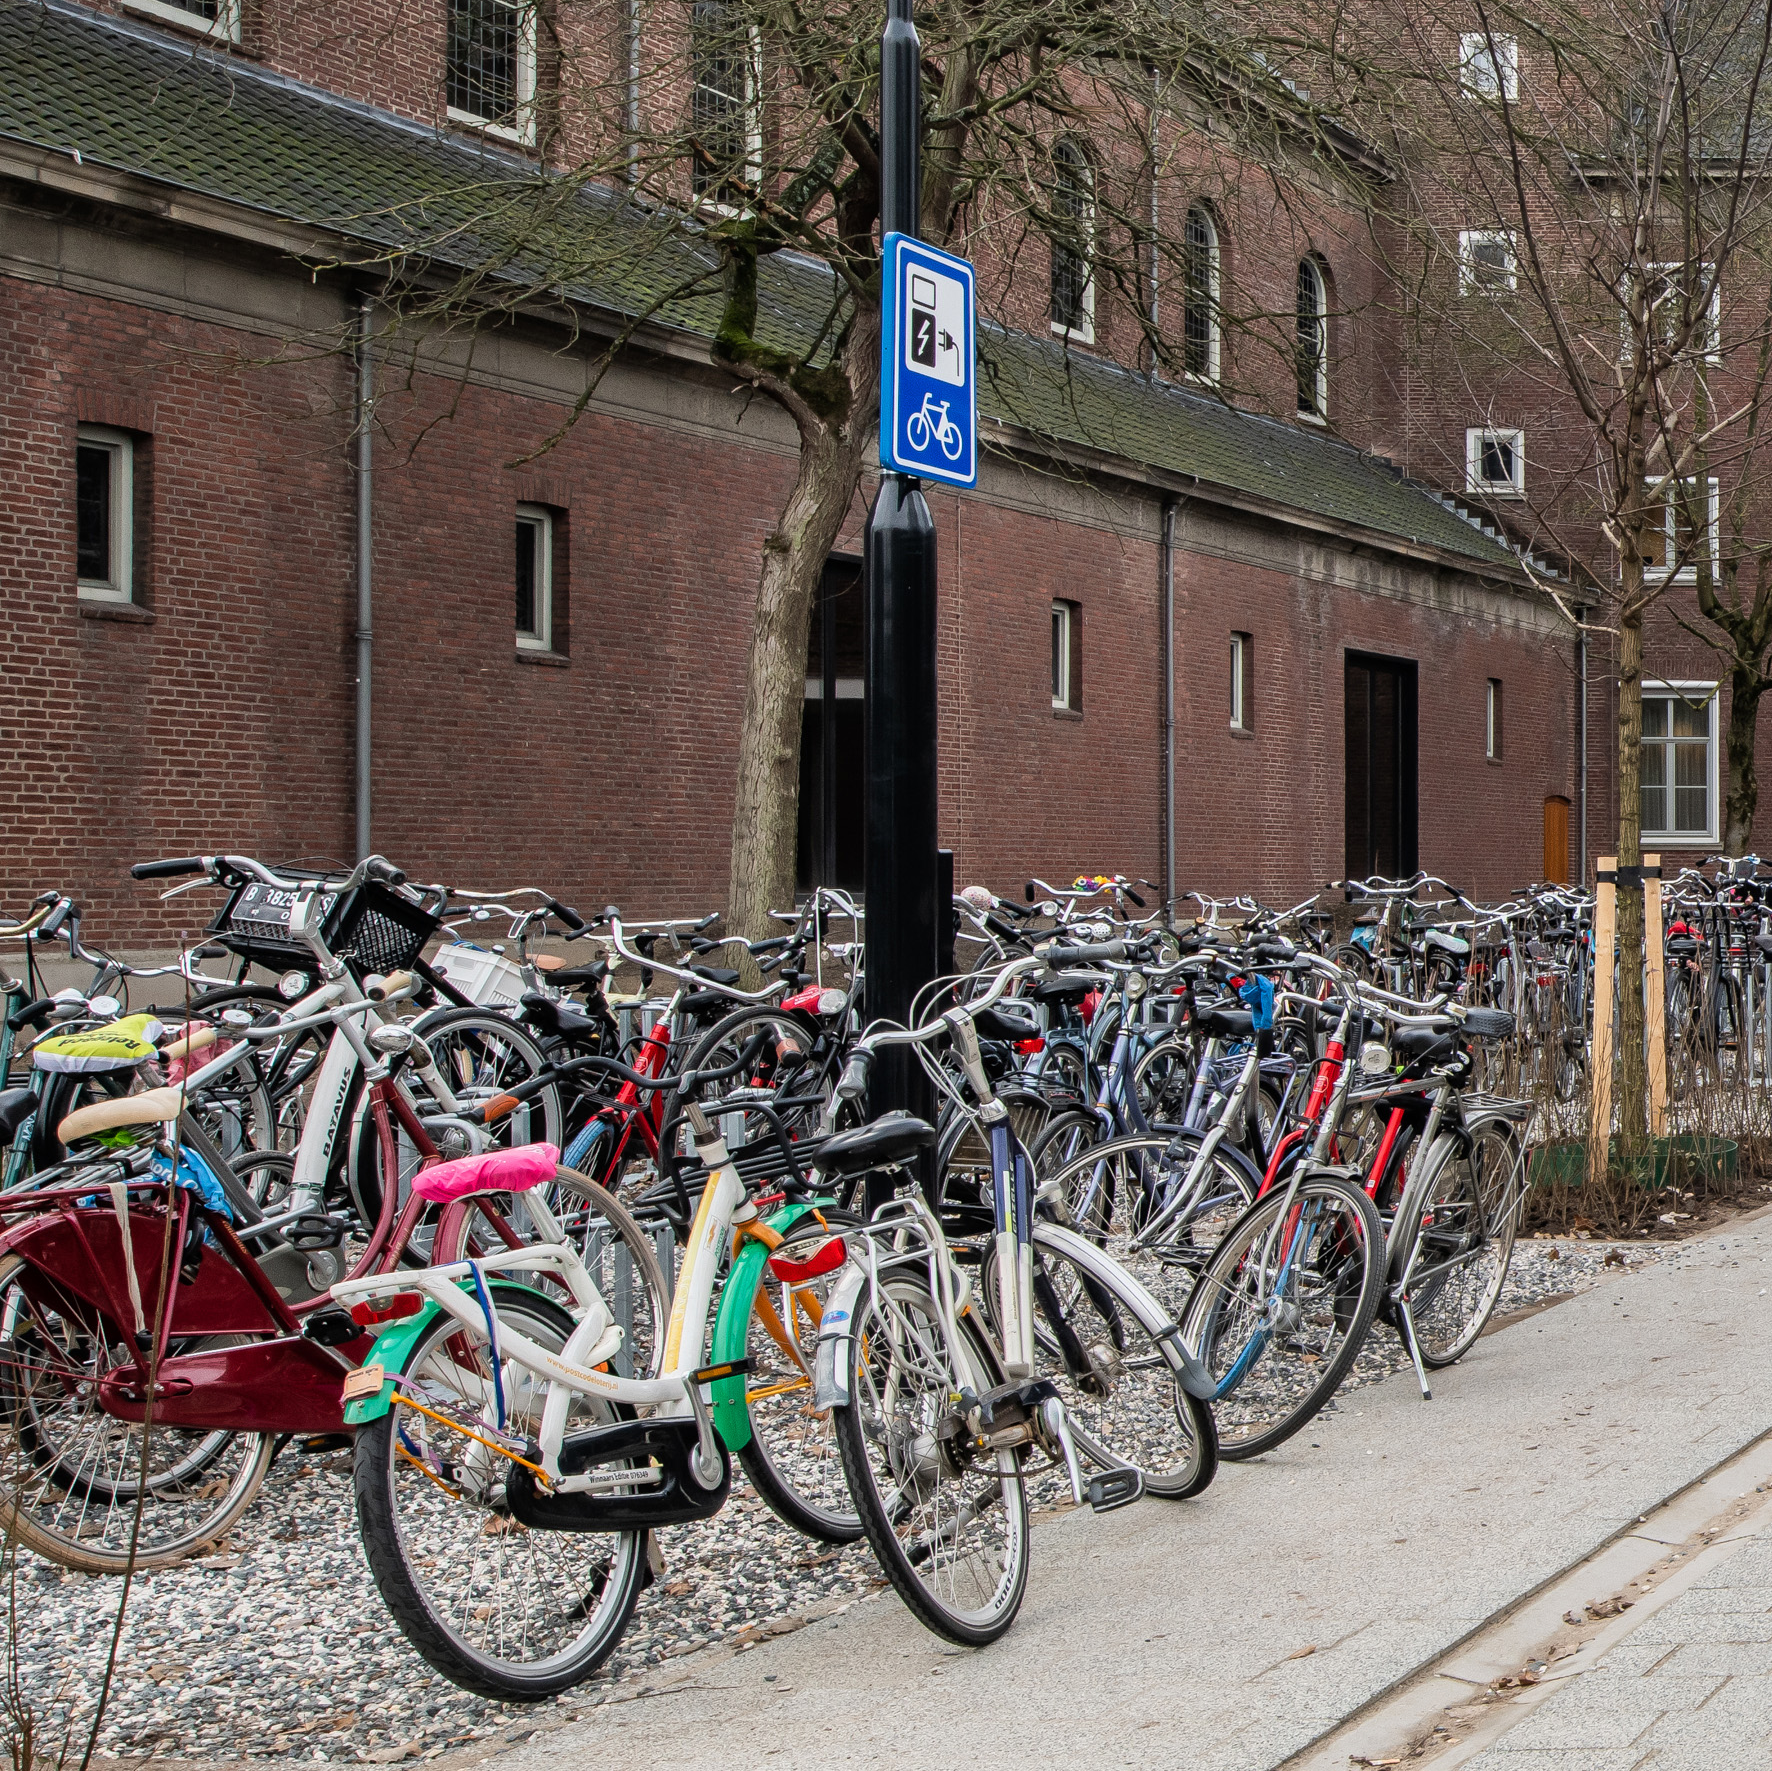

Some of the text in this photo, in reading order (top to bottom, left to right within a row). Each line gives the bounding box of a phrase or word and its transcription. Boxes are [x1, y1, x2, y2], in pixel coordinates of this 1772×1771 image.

[245, 887, 259, 901] B
[322, 1066, 352, 1158] BATAVUS
[672, 1274, 692, 1323] UNION
[546, 1356, 619, 1391] www.postcodeloterij.nl
[588, 1474, 614, 1484] Winnaars
[994, 1561, 1016, 1611] 2000
